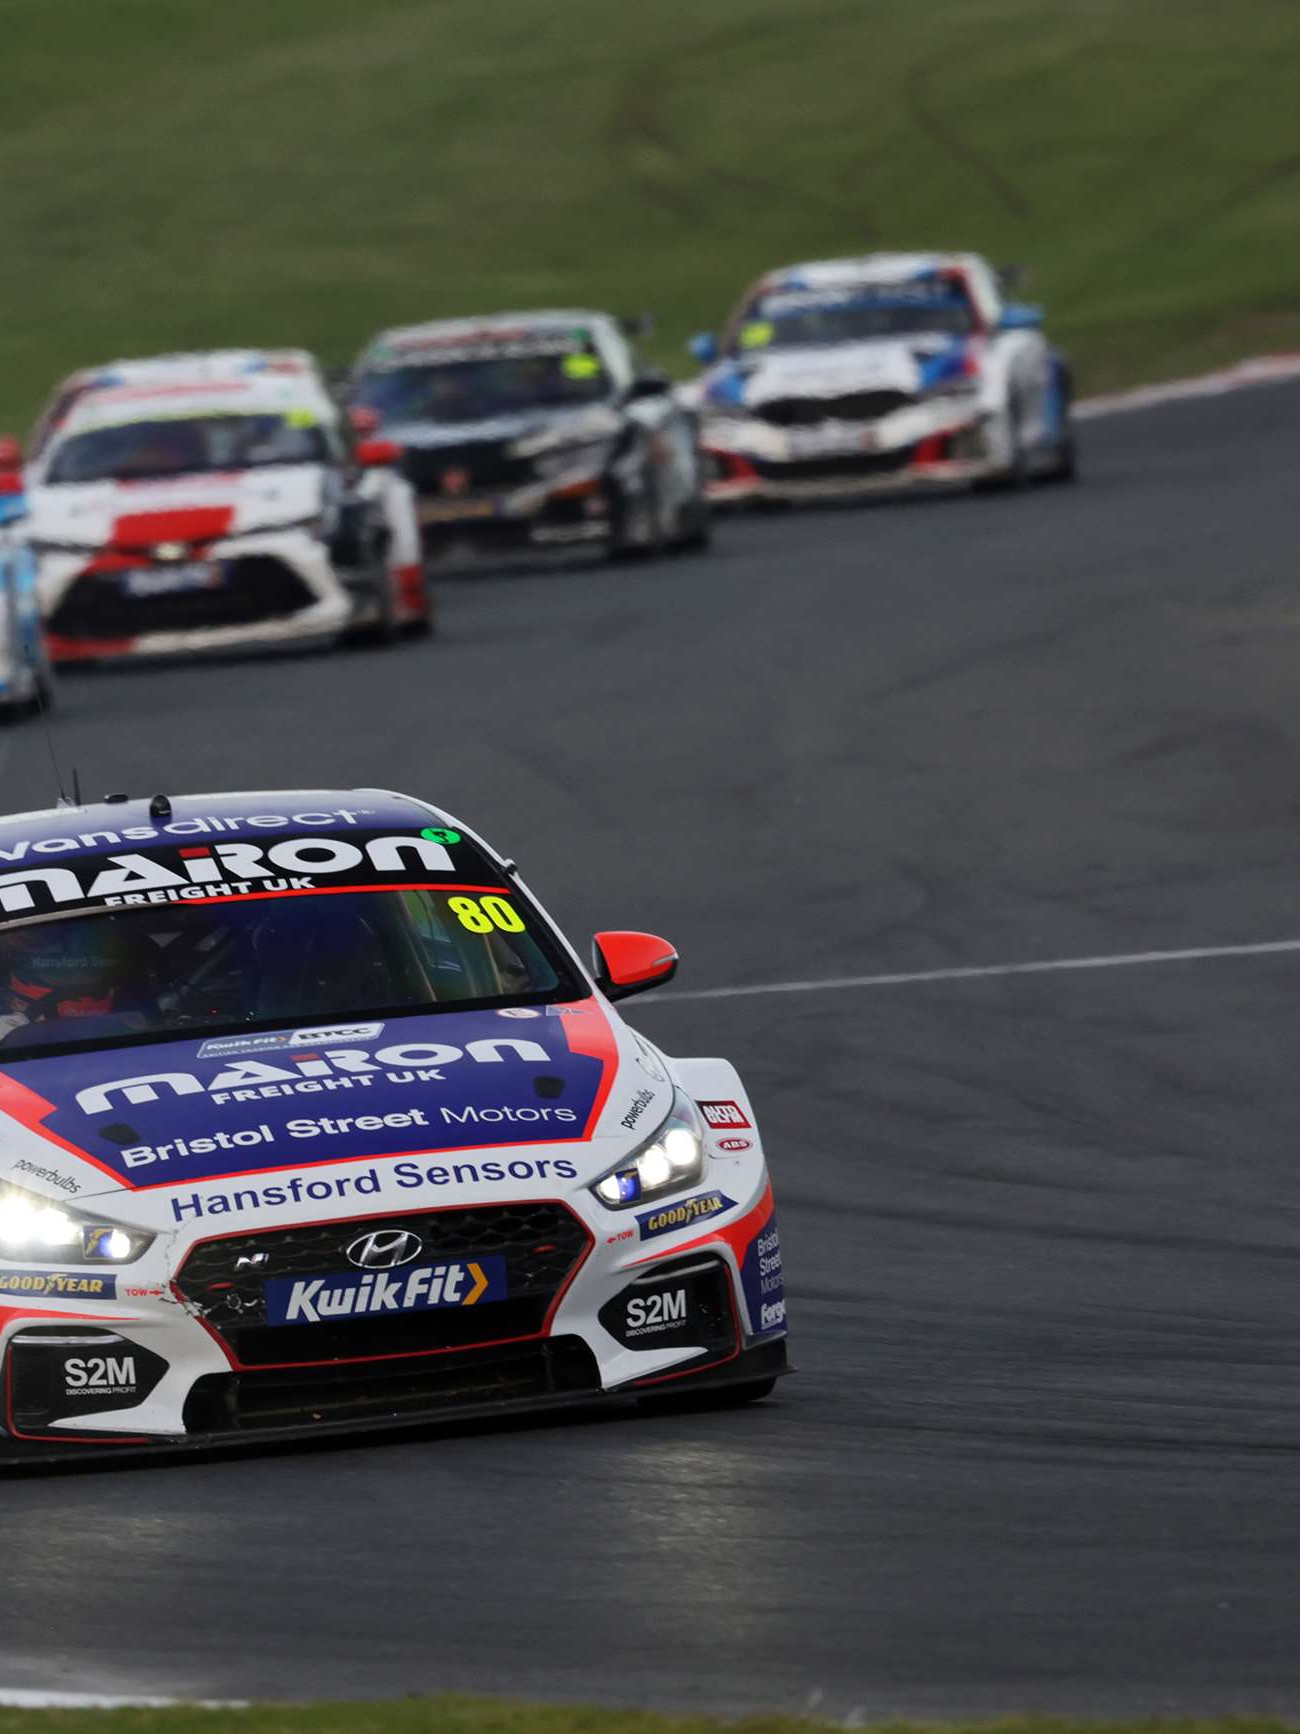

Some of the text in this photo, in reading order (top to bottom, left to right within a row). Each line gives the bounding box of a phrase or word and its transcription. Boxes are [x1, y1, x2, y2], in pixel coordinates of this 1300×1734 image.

[104, 876, 316, 907] FREIGHT UK
[447, 896, 526, 934] 80
[211, 1069, 446, 1105] FREIGHT UK
[621, 1089, 655, 1130] powerbulbs
[120, 1106, 577, 1168] Bristol Street Motors
[12, 1159, 82, 1194] powerbulbs
[171, 1160, 578, 1222] Hansford Sensors
[648, 1196, 723, 1230] GOODYEAR
[617, 1230, 635, 1241] TOW
[125, 1288, 148, 1297] TOW
[626, 1289, 687, 1327] S2M
[64, 1357, 136, 1387] S2M
[65, 1387, 112, 1395] DISCOVERING
